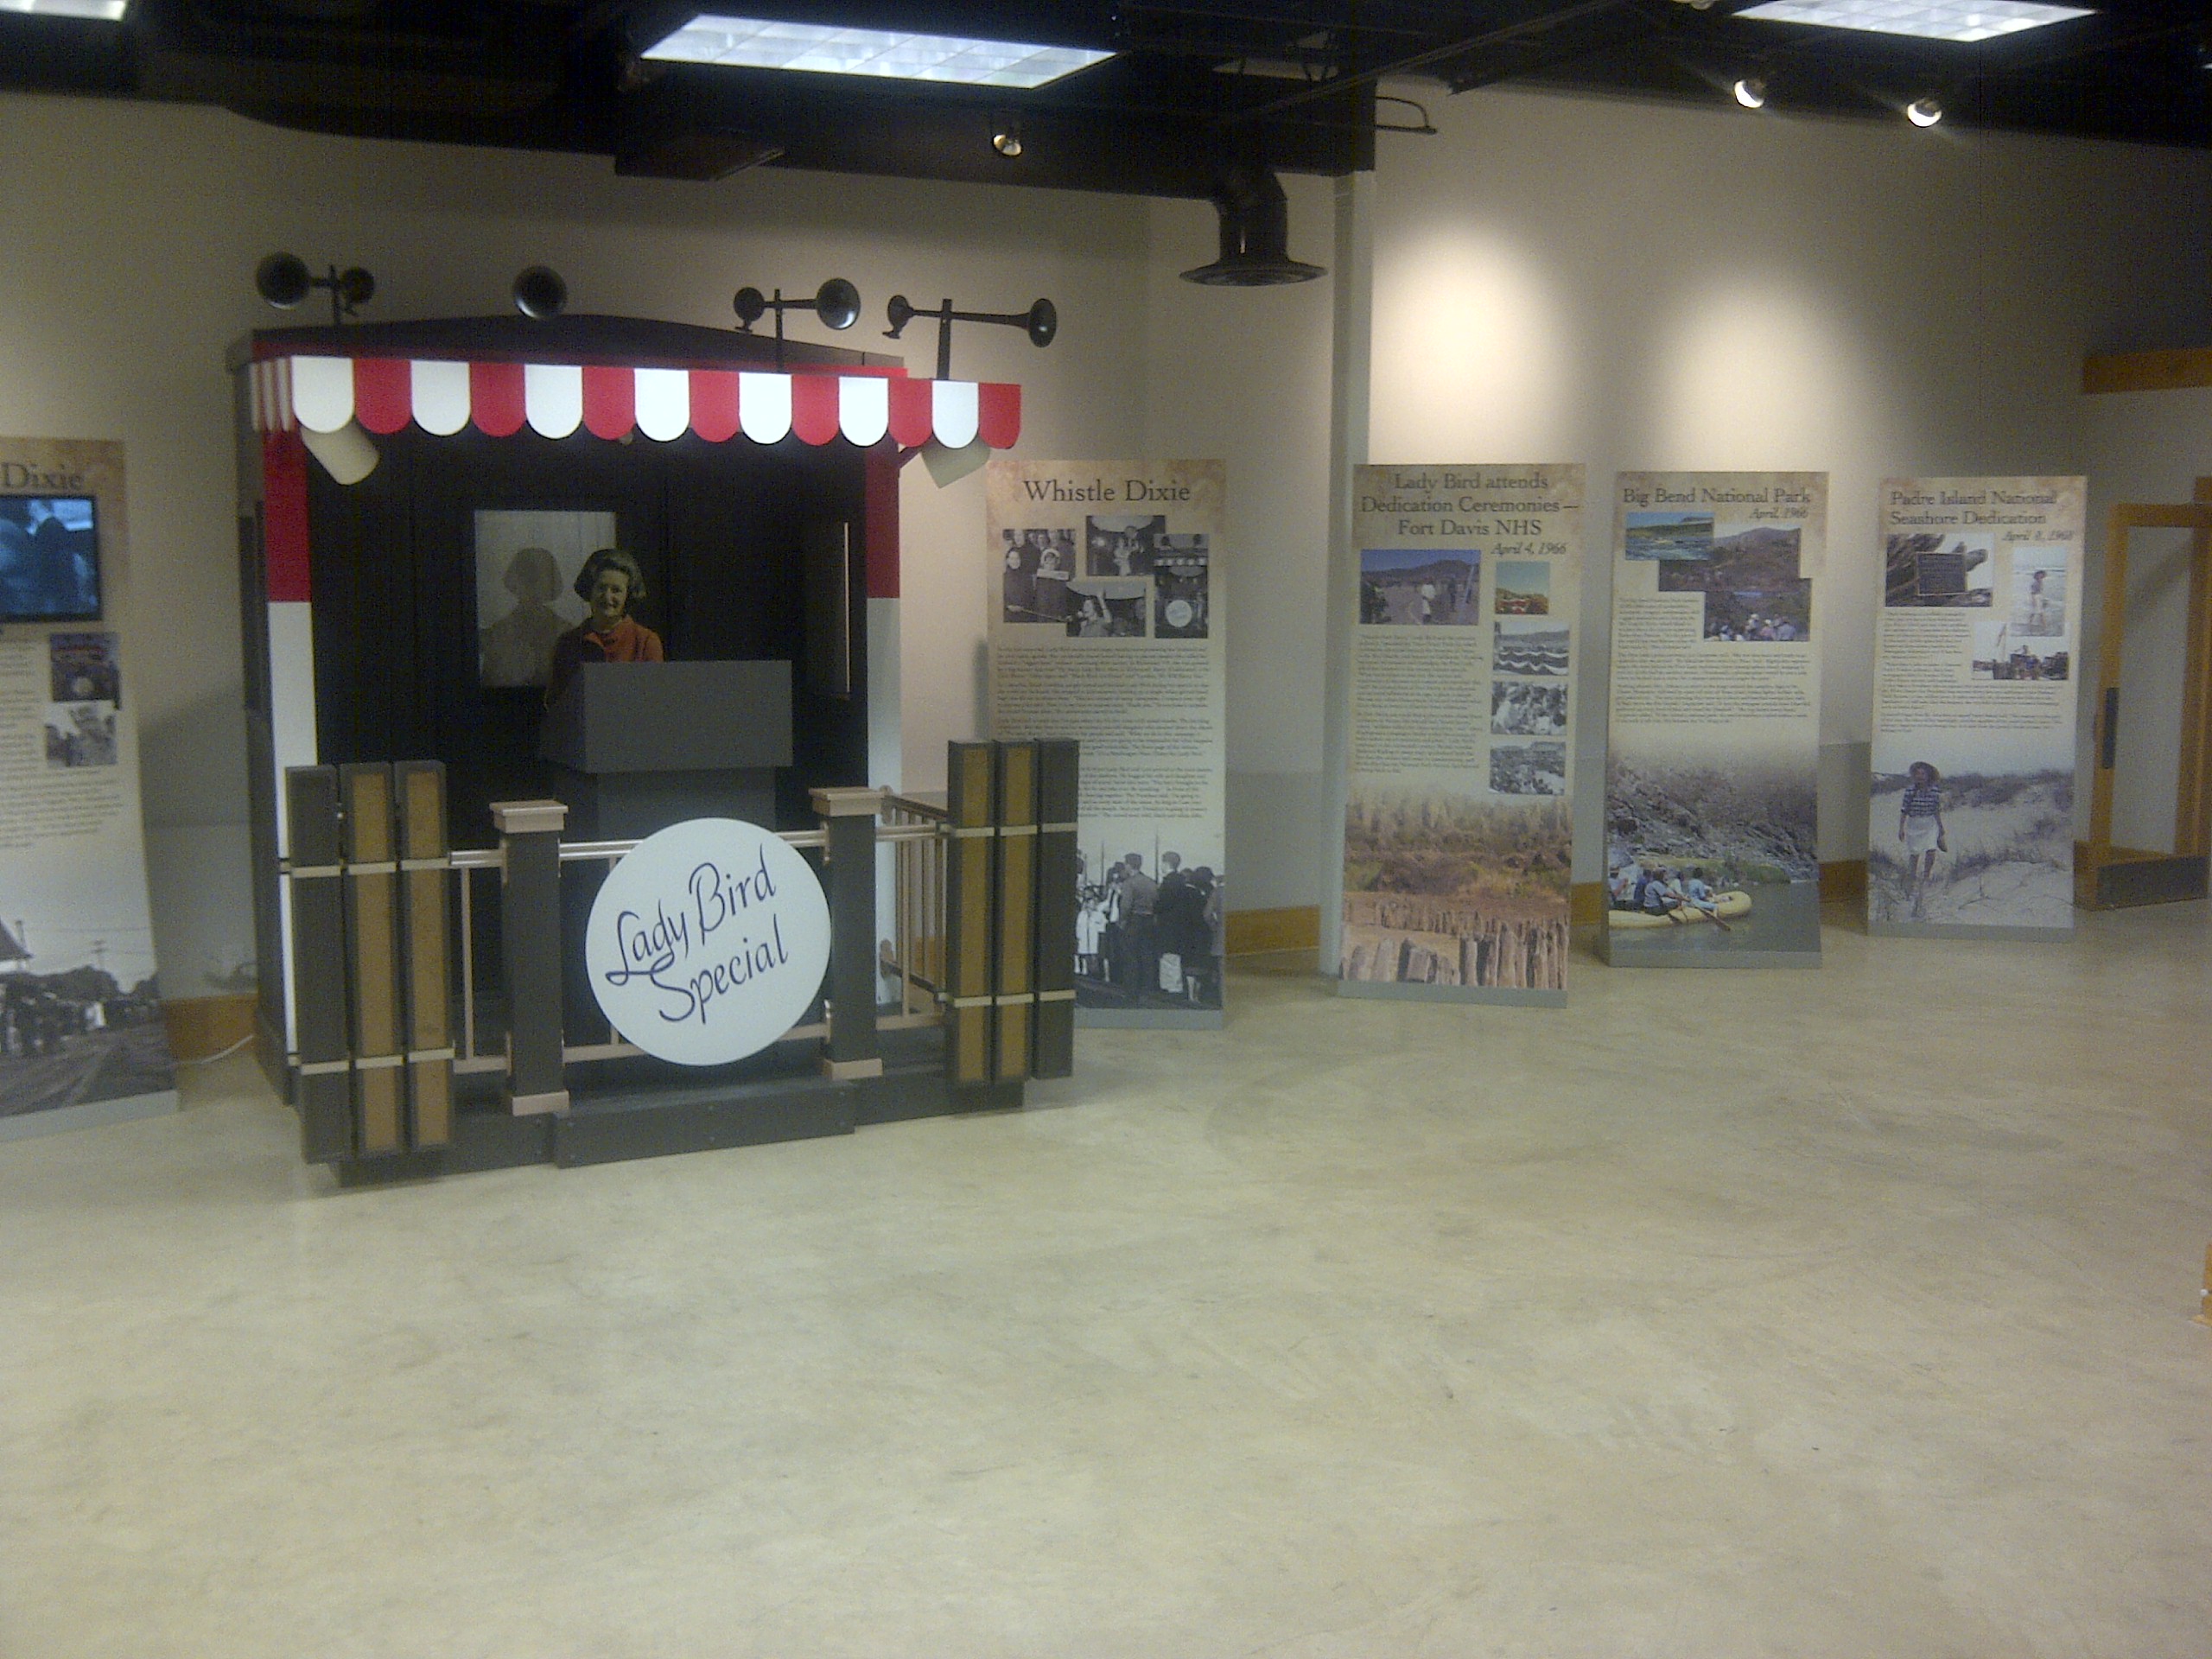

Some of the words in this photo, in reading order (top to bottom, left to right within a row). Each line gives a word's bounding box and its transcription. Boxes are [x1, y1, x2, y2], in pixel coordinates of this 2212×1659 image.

[2, 462, 84, 489] Dixie
[1395, 473, 1438, 493] Lady
[1444, 473, 1481, 490] Bird
[1485, 472, 1548, 490] attends
[1023, 479, 1116, 501] Whistle
[1125, 479, 1192, 501] Dixie
[1624, 487, 1650, 507] Big
[1655, 487, 1696, 503] Bend
[1701, 487, 1769, 503] National
[1773, 487, 1811, 503] Park
[1891, 491, 1935, 505] Padre
[1940, 491, 1986, 505] Island
[1992, 491, 2057, 505] National
[1361, 496, 1453, 512] Dedication
[1397, 519, 1434, 536] Fort
[1440, 519, 1490, 536] Davis
[1496, 519, 1542, 536] NHS
[1890, 511, 1958, 524] Seashore
[1962, 511, 2046, 524] Dedication
[1491, 542, 1522, 557] April
[605, 899, 689, 986] Lady
[689, 843, 777, 946] Bird
[650, 913, 788, 1025] Special
